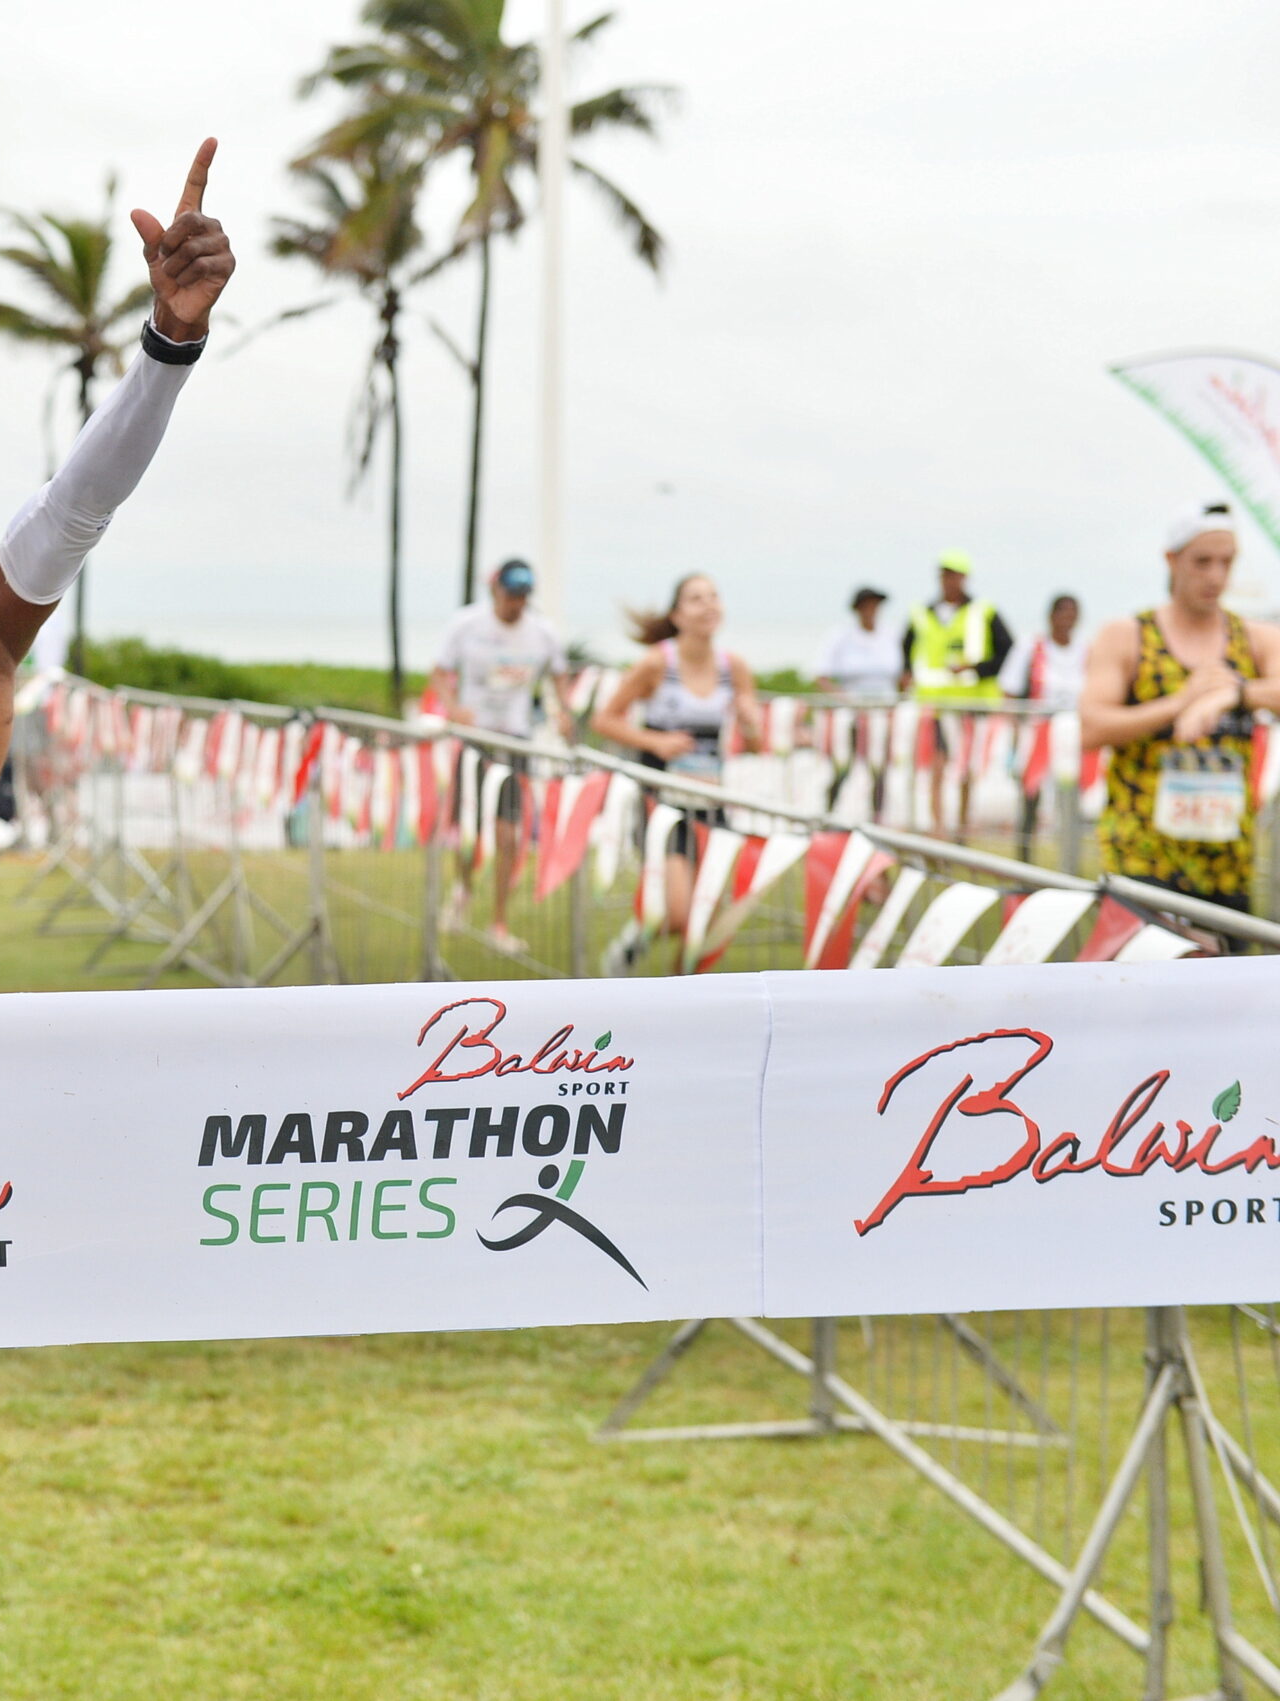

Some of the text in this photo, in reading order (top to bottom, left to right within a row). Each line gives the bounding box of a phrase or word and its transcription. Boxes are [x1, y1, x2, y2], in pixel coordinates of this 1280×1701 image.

[397, 997, 635, 1101] Balwin
[558, 1081, 630, 1097] SPORT
[198, 1103, 627, 1167] MARATHON
[199, 1177, 458, 1246] SERIES
